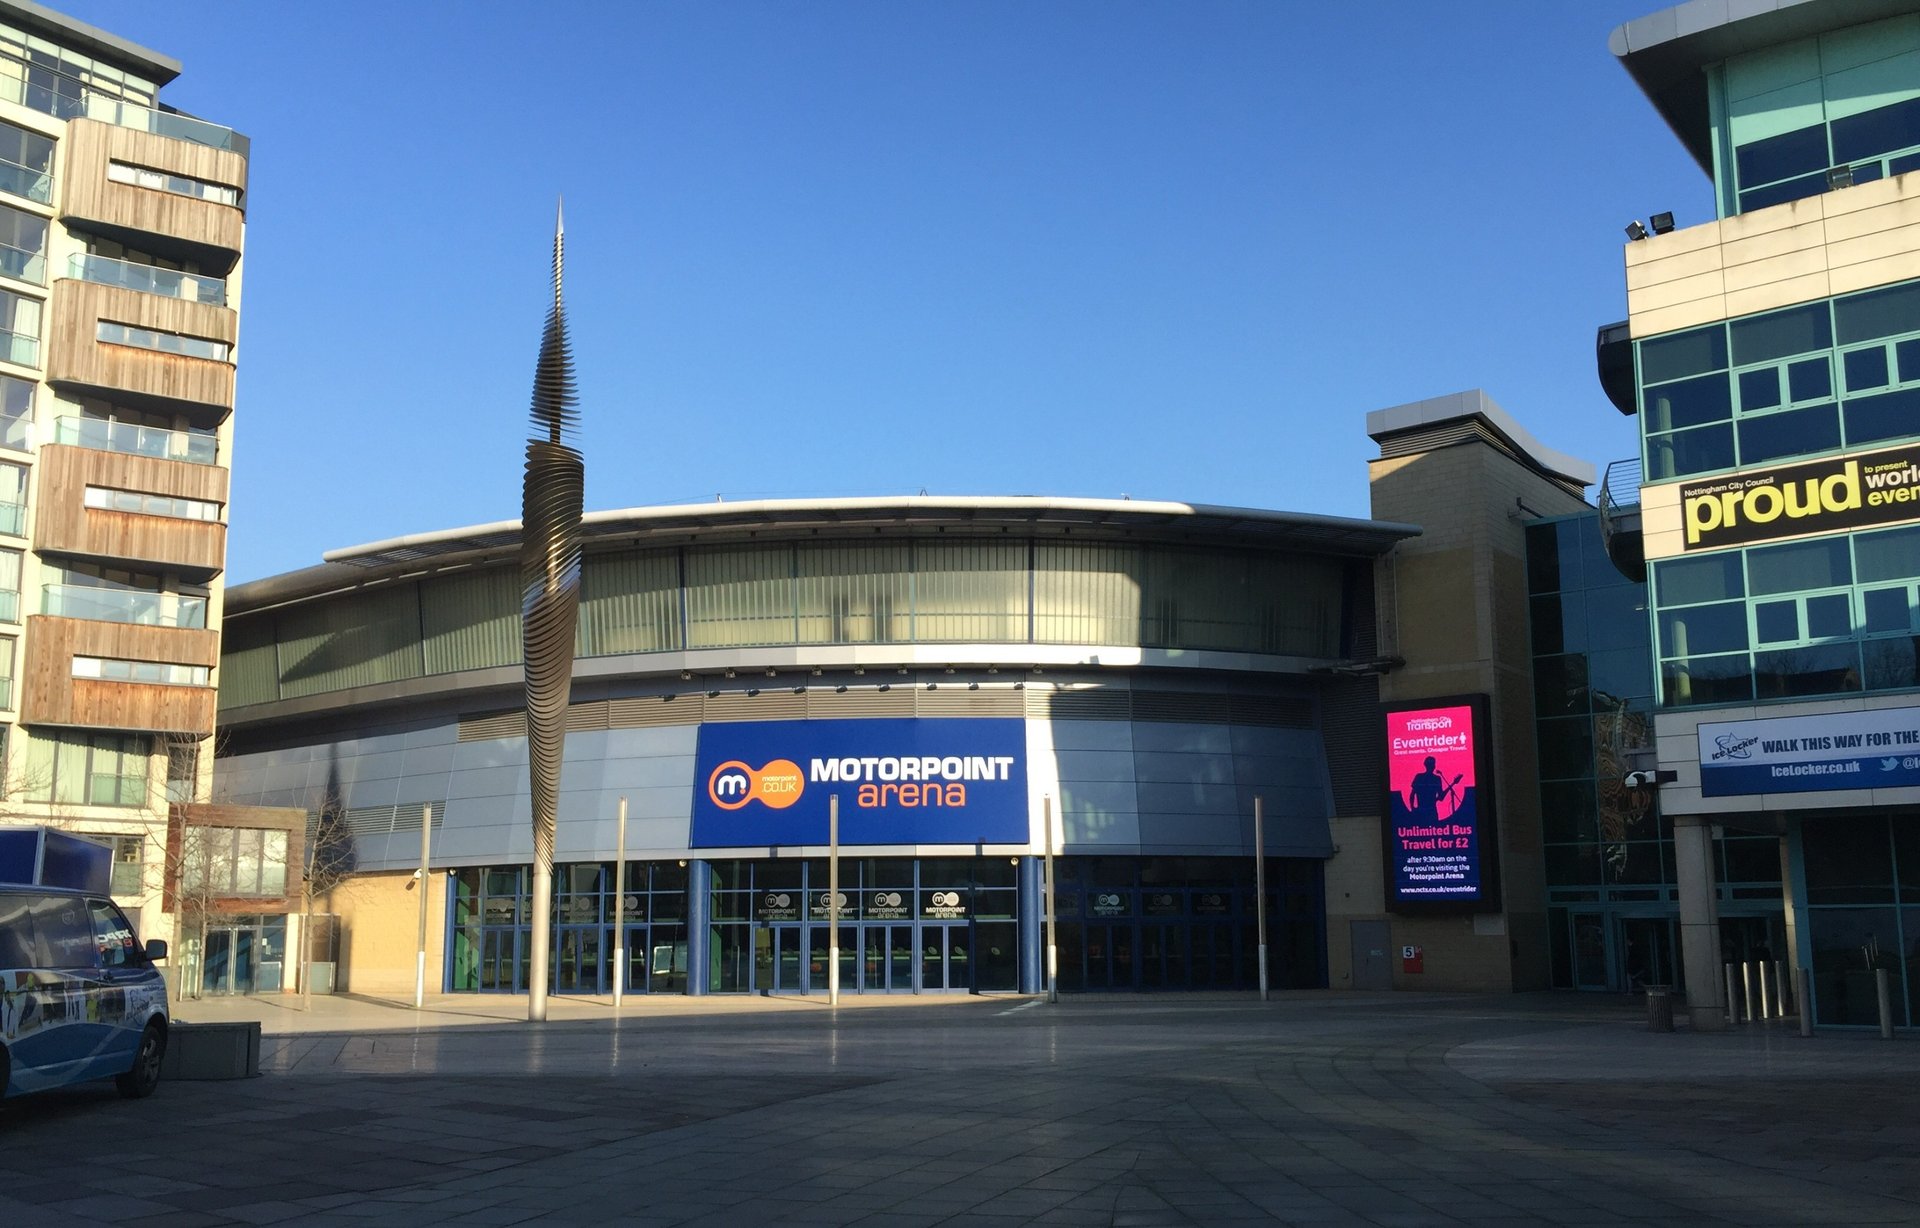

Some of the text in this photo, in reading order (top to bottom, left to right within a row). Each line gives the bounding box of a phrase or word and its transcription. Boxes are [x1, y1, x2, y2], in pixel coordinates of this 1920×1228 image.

[1875, 460, 1908, 473] present
[1865, 464, 1920, 489] worl
[1684, 476, 1774, 497] Nottingham City Council
[1685, 460, 1862, 544] proud
[1406, 719, 1452, 731] Transport
[1393, 734, 1458, 749] Eventrider
[1762, 730, 1919, 753] WALK THIS WAY FOR THE
[810, 756, 1014, 781] MOTORPOINT
[1771, 761, 1860, 777] IceLocker.co.uk
[1902, 757, 1920, 770] @I
[857, 783, 966, 807] arena
[1398, 825, 1472, 837] Unlimited Bus
[1402, 838, 1469, 850] Travel for £2
[1403, 865, 1414, 873] day
[1415, 865, 1435, 873] you're
[1435, 864, 1458, 872] visiting
[1409, 873, 1444, 881] Motorpoint
[1405, 947, 1412, 957] 5
